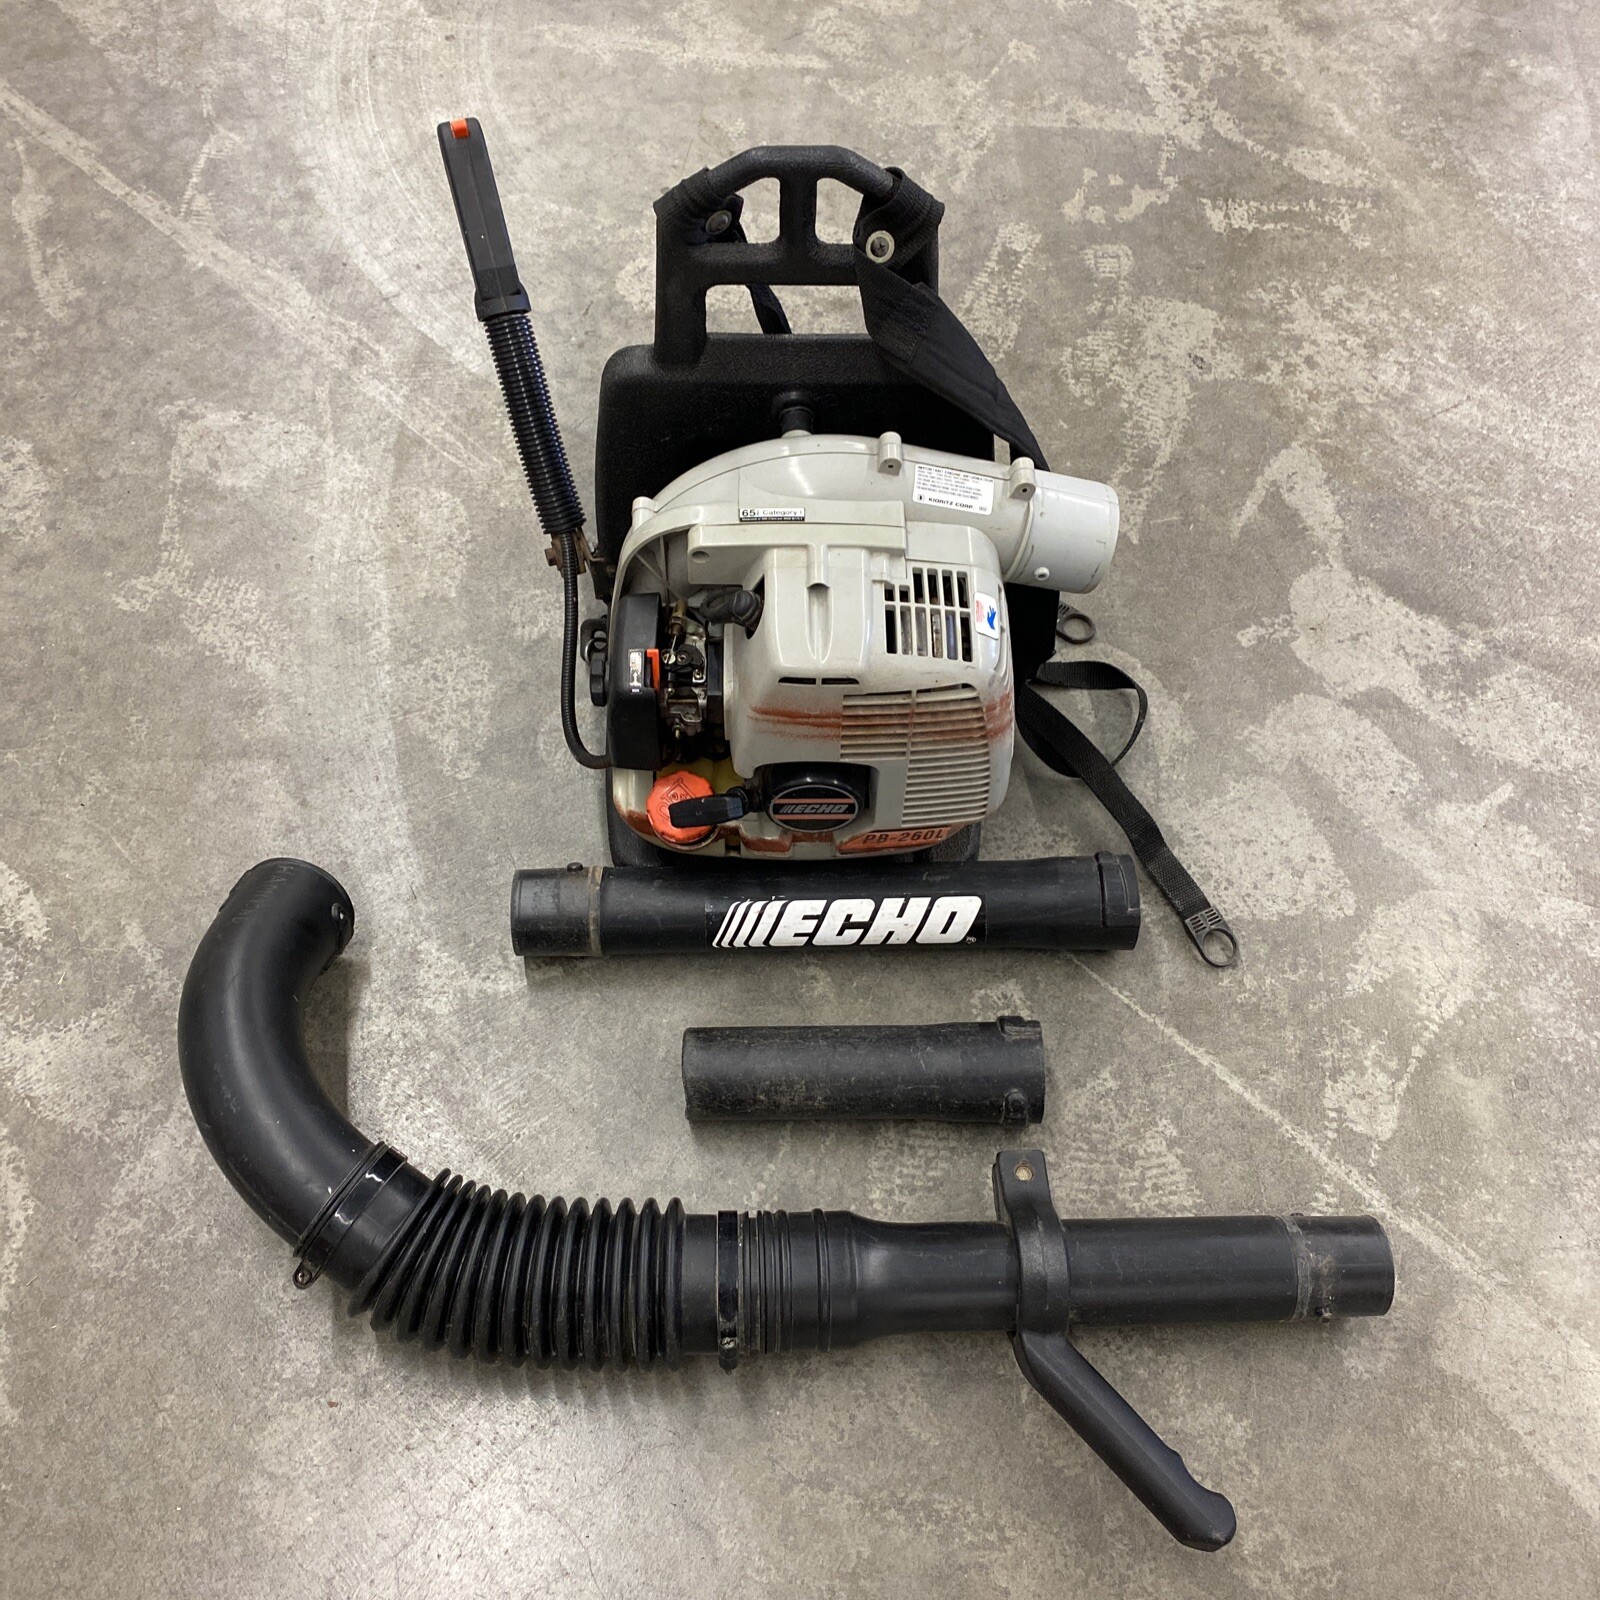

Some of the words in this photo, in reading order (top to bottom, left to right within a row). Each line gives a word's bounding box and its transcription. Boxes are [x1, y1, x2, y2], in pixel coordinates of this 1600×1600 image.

[928, 497, 954, 506] KIORITZ
[742, 509, 756, 517] 65
[762, 509, 798, 517] Category
[793, 804, 849, 814] ECHO
[862, 828, 944, 845] PB-260L
[768, 896, 982, 947] ECHO
